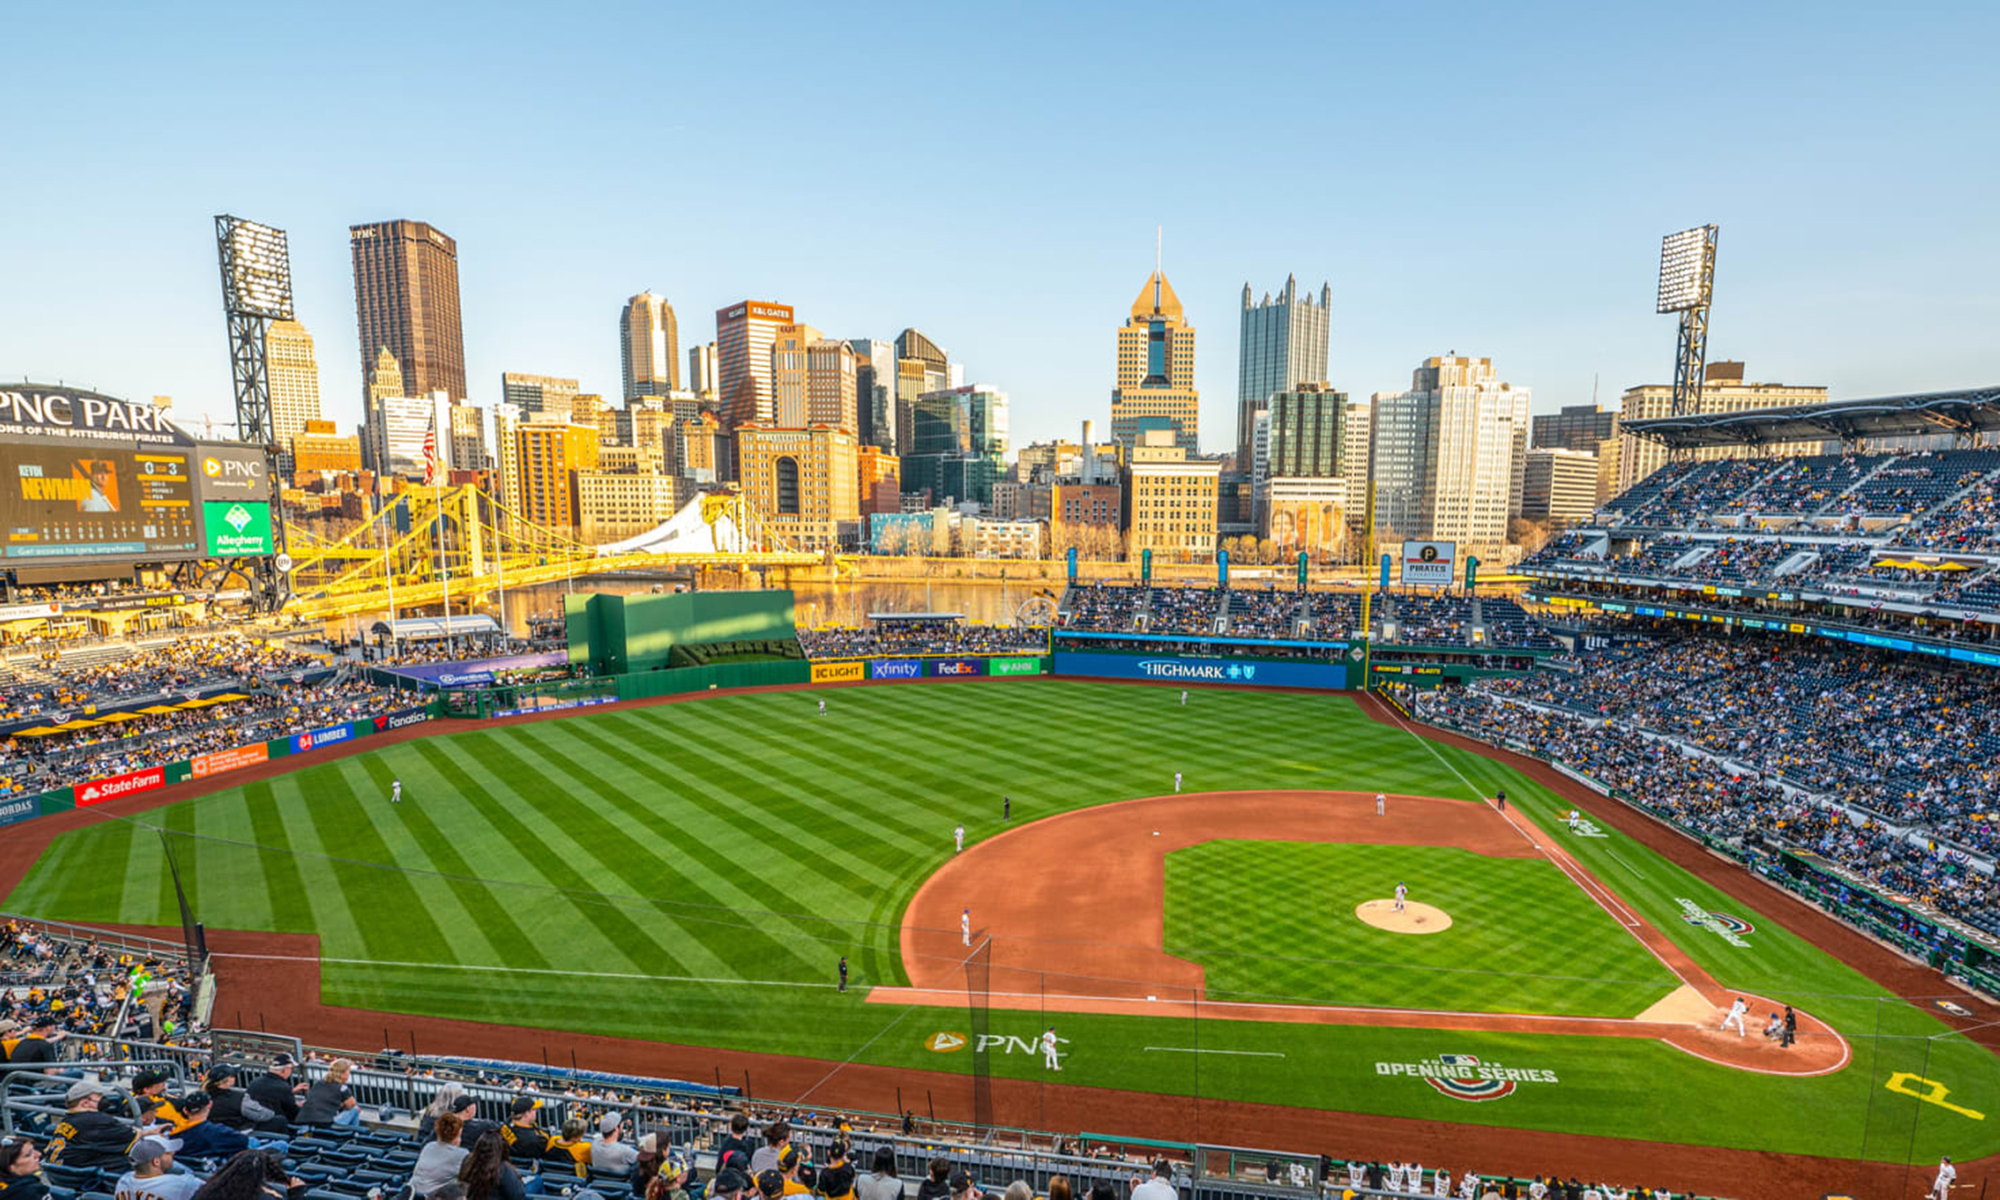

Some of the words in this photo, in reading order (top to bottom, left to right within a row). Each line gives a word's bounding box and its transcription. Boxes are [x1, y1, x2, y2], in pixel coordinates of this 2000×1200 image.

[350, 228, 377, 240] UPMC
[767, 309, 790, 319] GATES
[78, 398, 175, 433] PARK
[26, 425, 43, 435] OF
[44, 427, 67, 437] THE
[168, 462, 178, 475] 3
[223, 460, 262, 477] PNC
[20, 477, 93, 501] NEWMAN
[216, 535, 264, 546] Allegheny
[1409, 564, 1447, 573] PIRATES
[829, 667, 860, 678] LIGHT
[875, 662, 918, 678] xfinity
[938, 662, 973, 675] FedEx
[1146, 663, 1225, 679] HIGHMARK
[389, 711, 427, 729] Fanatics
[313, 728, 348, 745] LUMBER
[101, 781, 132, 797] State
[132, 774, 161, 789] Farm
[1375, 1062, 1473, 1079] OPENING
[1479, 1066, 1560, 1083] SERIES
